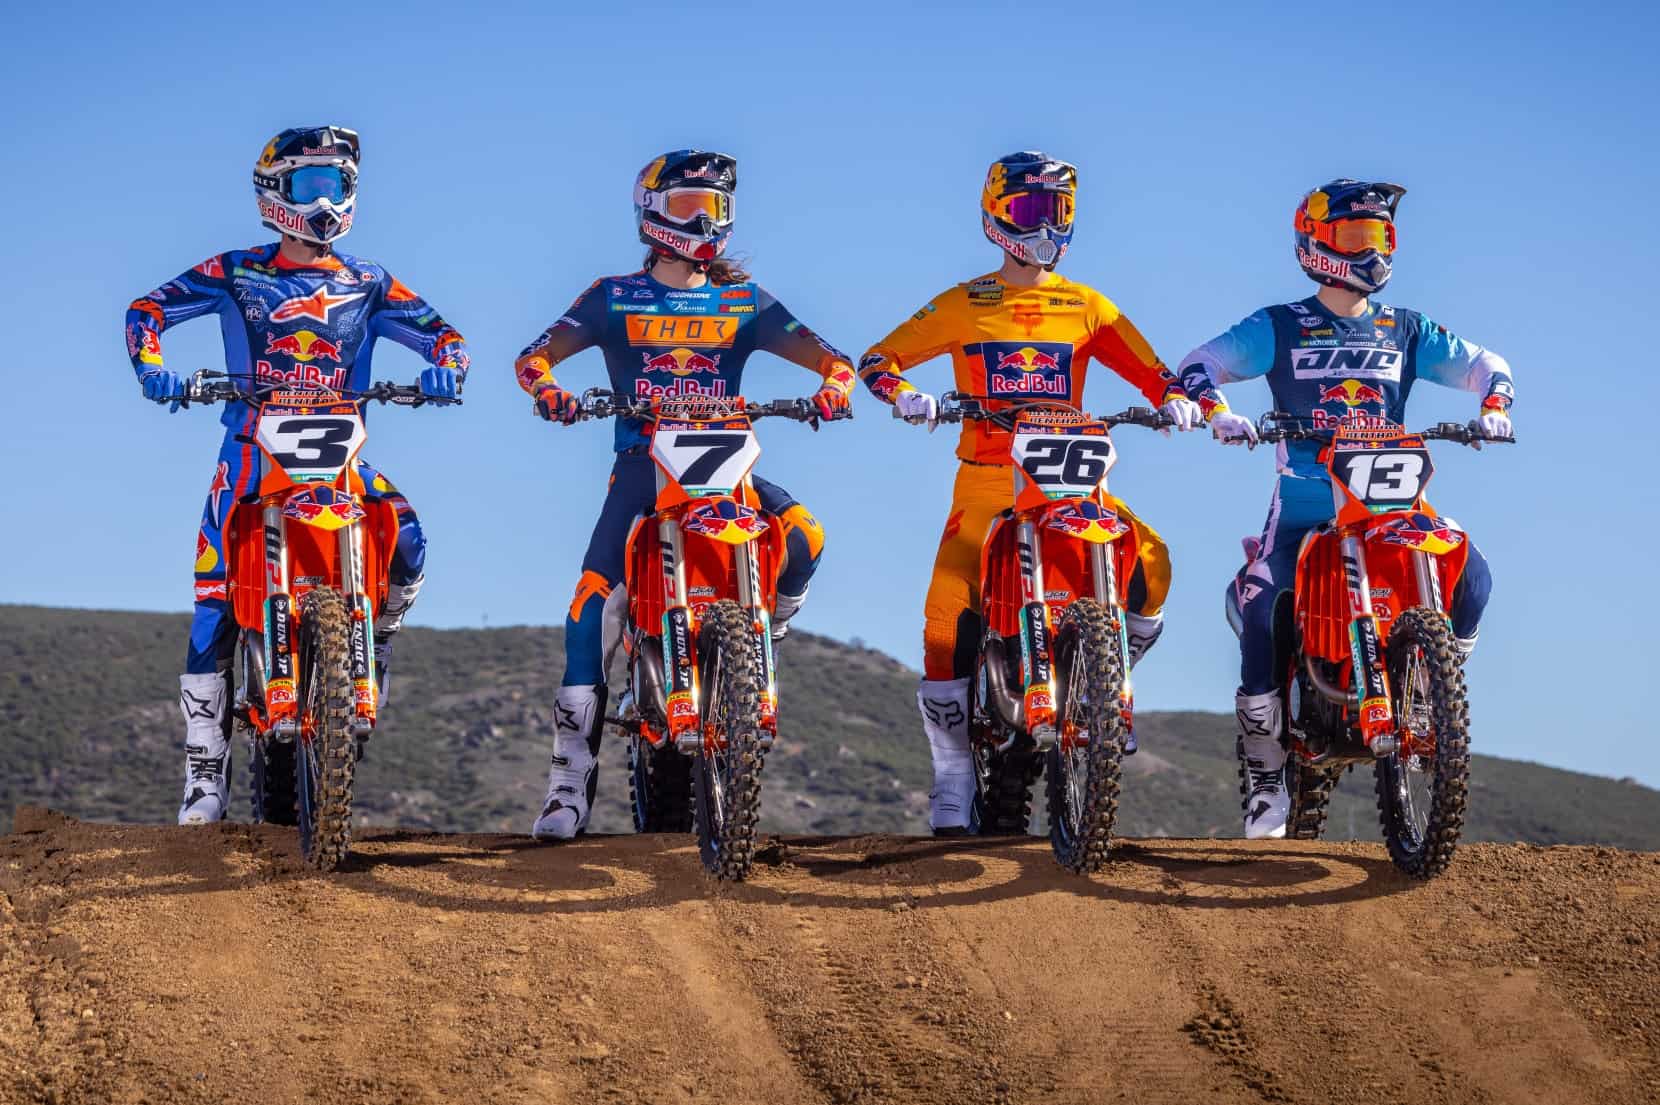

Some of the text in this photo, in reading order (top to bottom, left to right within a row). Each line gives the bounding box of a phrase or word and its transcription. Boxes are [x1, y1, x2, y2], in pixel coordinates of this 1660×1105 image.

[638, 319, 727, 339] THOR
[272, 419, 355, 469] 3
[674, 434, 748, 485] 7
[1023, 439, 1110, 486] 26
[1346, 454, 1424, 500] 13
[277, 611, 288, 675] DUNP
[676, 624, 689, 688] DUNP
[1033, 620, 1047, 681] DUNP
[1365, 631, 1383, 694] DUNOP
